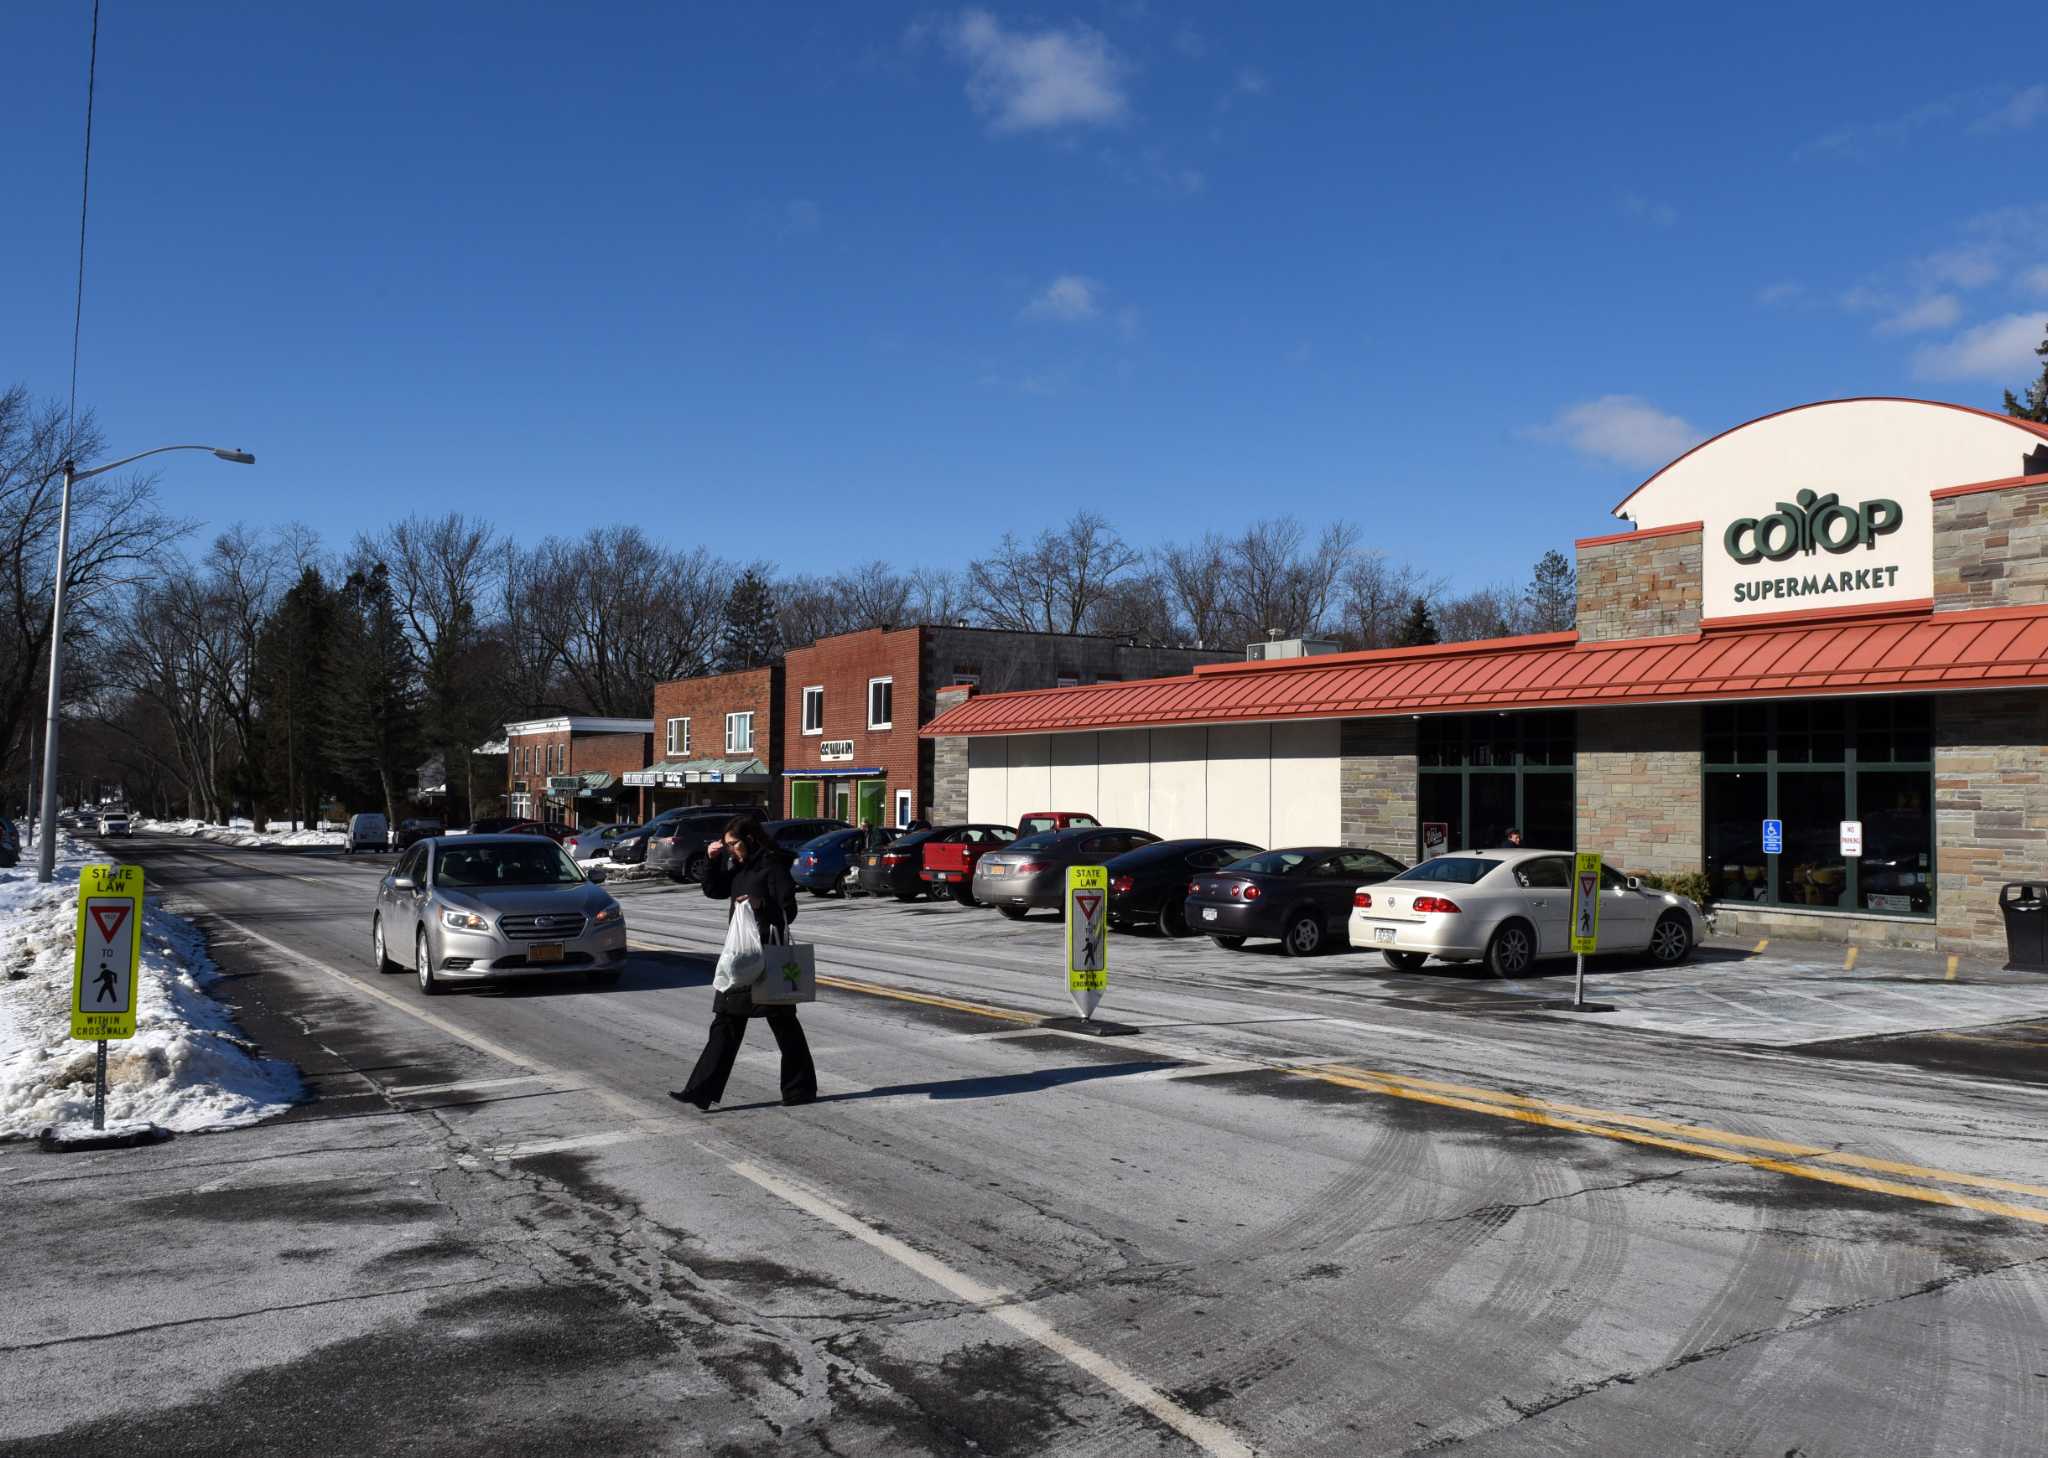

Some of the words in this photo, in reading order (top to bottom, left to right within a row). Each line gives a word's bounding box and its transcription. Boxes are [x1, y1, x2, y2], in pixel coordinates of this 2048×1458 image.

[1734, 565, 1898, 602] SUPERMARKET
[92, 868, 133, 880] STATE
[1076, 869, 1100, 878] STATE
[96, 881, 126, 893] LAW
[1080, 879, 1098, 888] LAW
[101, 948, 114, 958] TO
[86, 1015, 120, 1025] WITHIN
[76, 1026, 129, 1036] CROSSWALK
